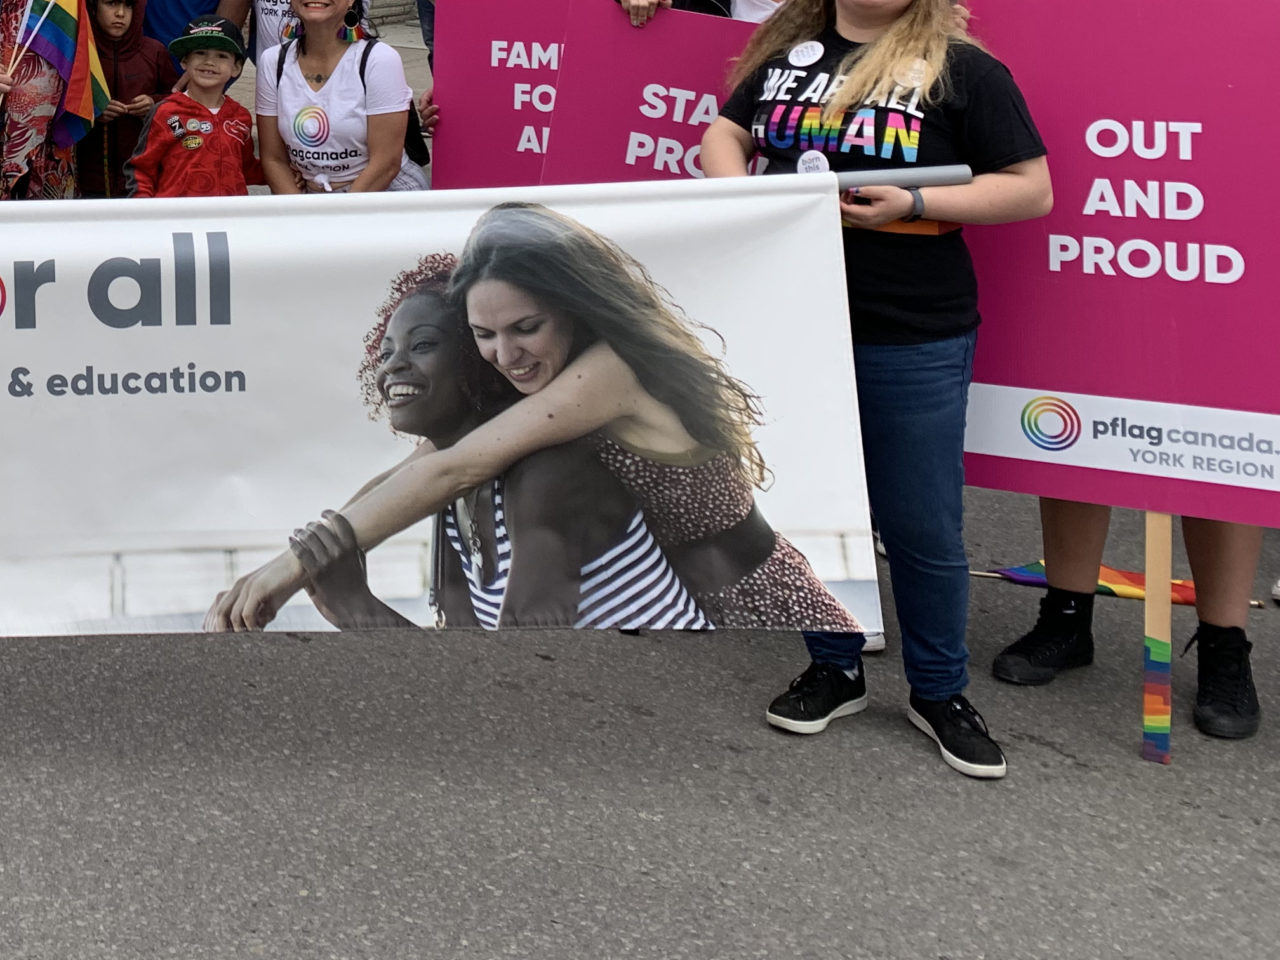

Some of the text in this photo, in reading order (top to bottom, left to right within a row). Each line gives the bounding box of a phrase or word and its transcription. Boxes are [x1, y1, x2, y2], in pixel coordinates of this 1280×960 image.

[492, 41, 565, 69] FAM
[514, 84, 556, 112] FO
[639, 84, 719, 126] STA
[759, 68, 807, 101] WE
[752, 104, 921, 163] HUMAN
[1086, 119, 1202, 160] OUT
[1083, 179, 1204, 220] AND
[88, 232, 232, 326] all
[1049, 235, 1244, 283] PROUD
[8, 367, 34, 397] &
[47, 363, 246, 396] education
[1129, 448, 1274, 479] YORK REGION
